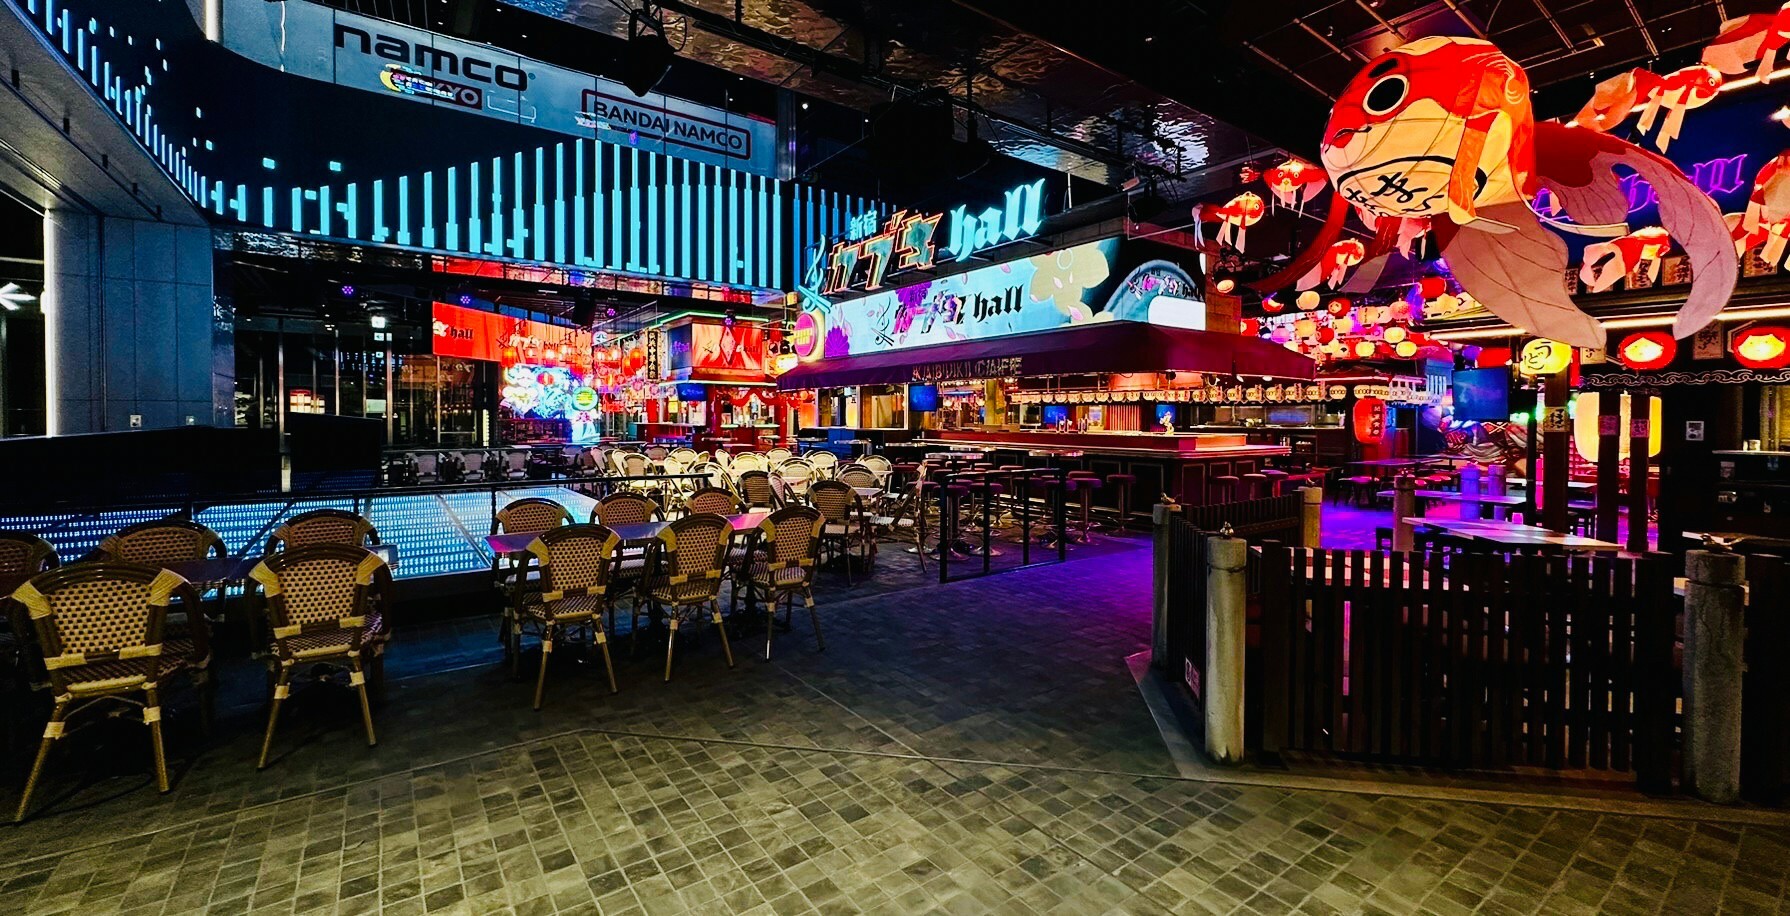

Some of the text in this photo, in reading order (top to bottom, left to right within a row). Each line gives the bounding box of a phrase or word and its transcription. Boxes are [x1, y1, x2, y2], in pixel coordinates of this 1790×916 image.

[335, 23, 529, 91] namco
[594, 101, 743, 149] BANDAI NAMCO
[849, 209, 878, 241] 新宿
[948, 178, 1046, 263] hall
[973, 283, 1024, 323] hall
